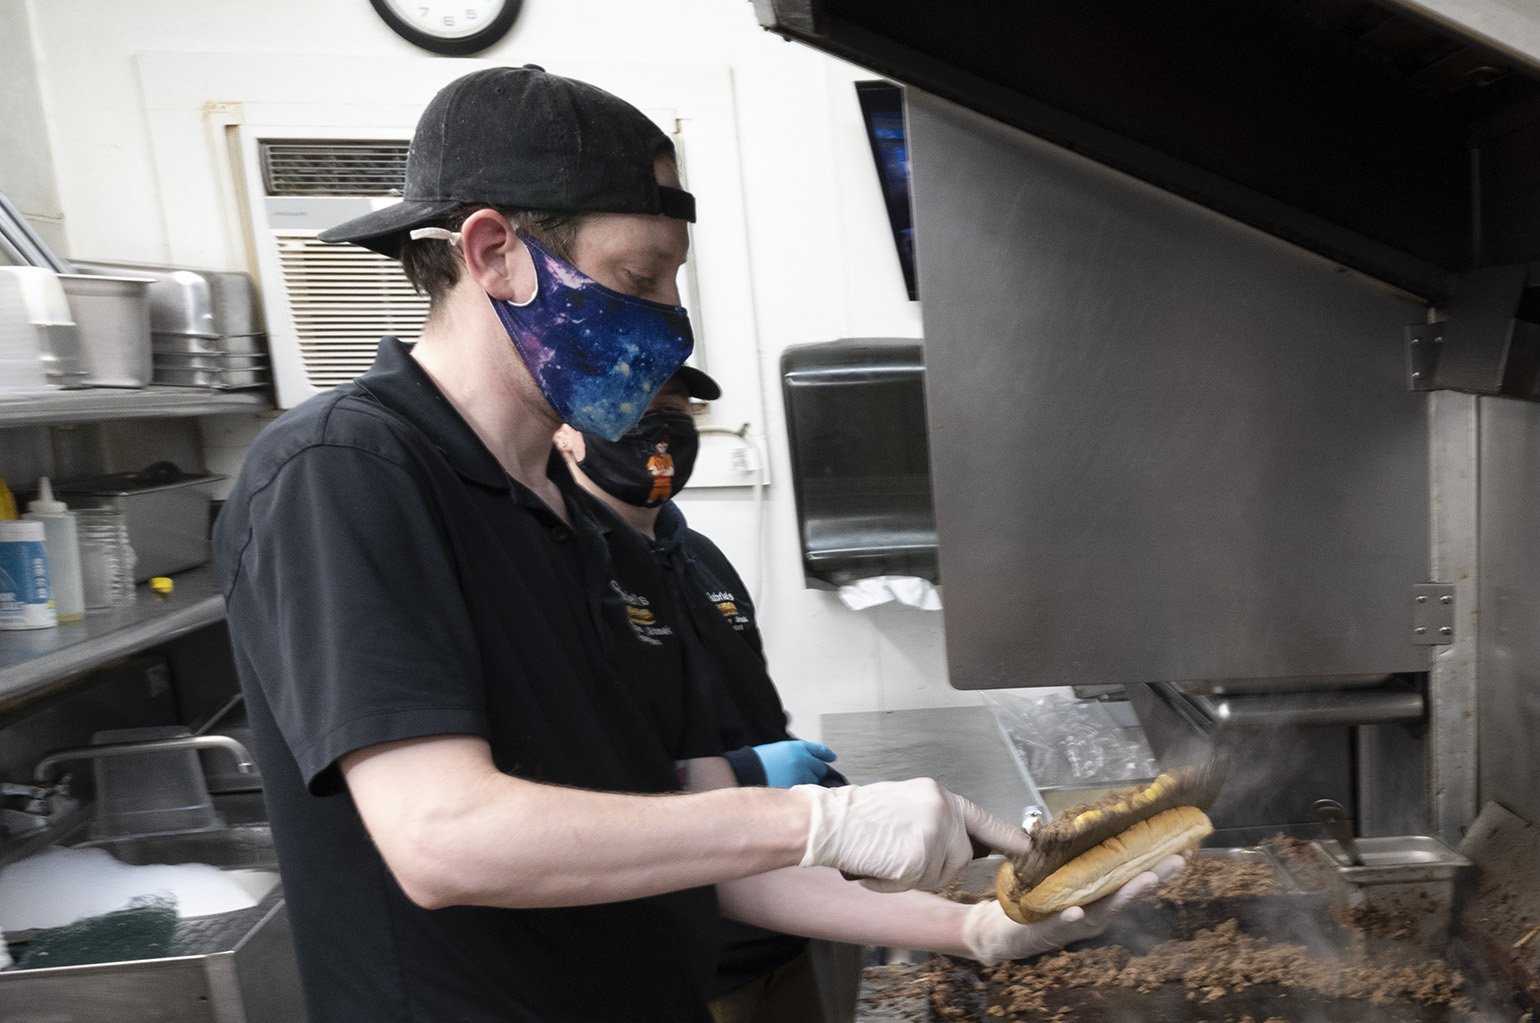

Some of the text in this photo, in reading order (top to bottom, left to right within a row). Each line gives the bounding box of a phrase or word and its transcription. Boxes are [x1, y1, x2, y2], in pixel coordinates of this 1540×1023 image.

[418, 7, 430, 17] 7
[465, 9, 478, 19] 5
[443, 16, 455, 27] 6
